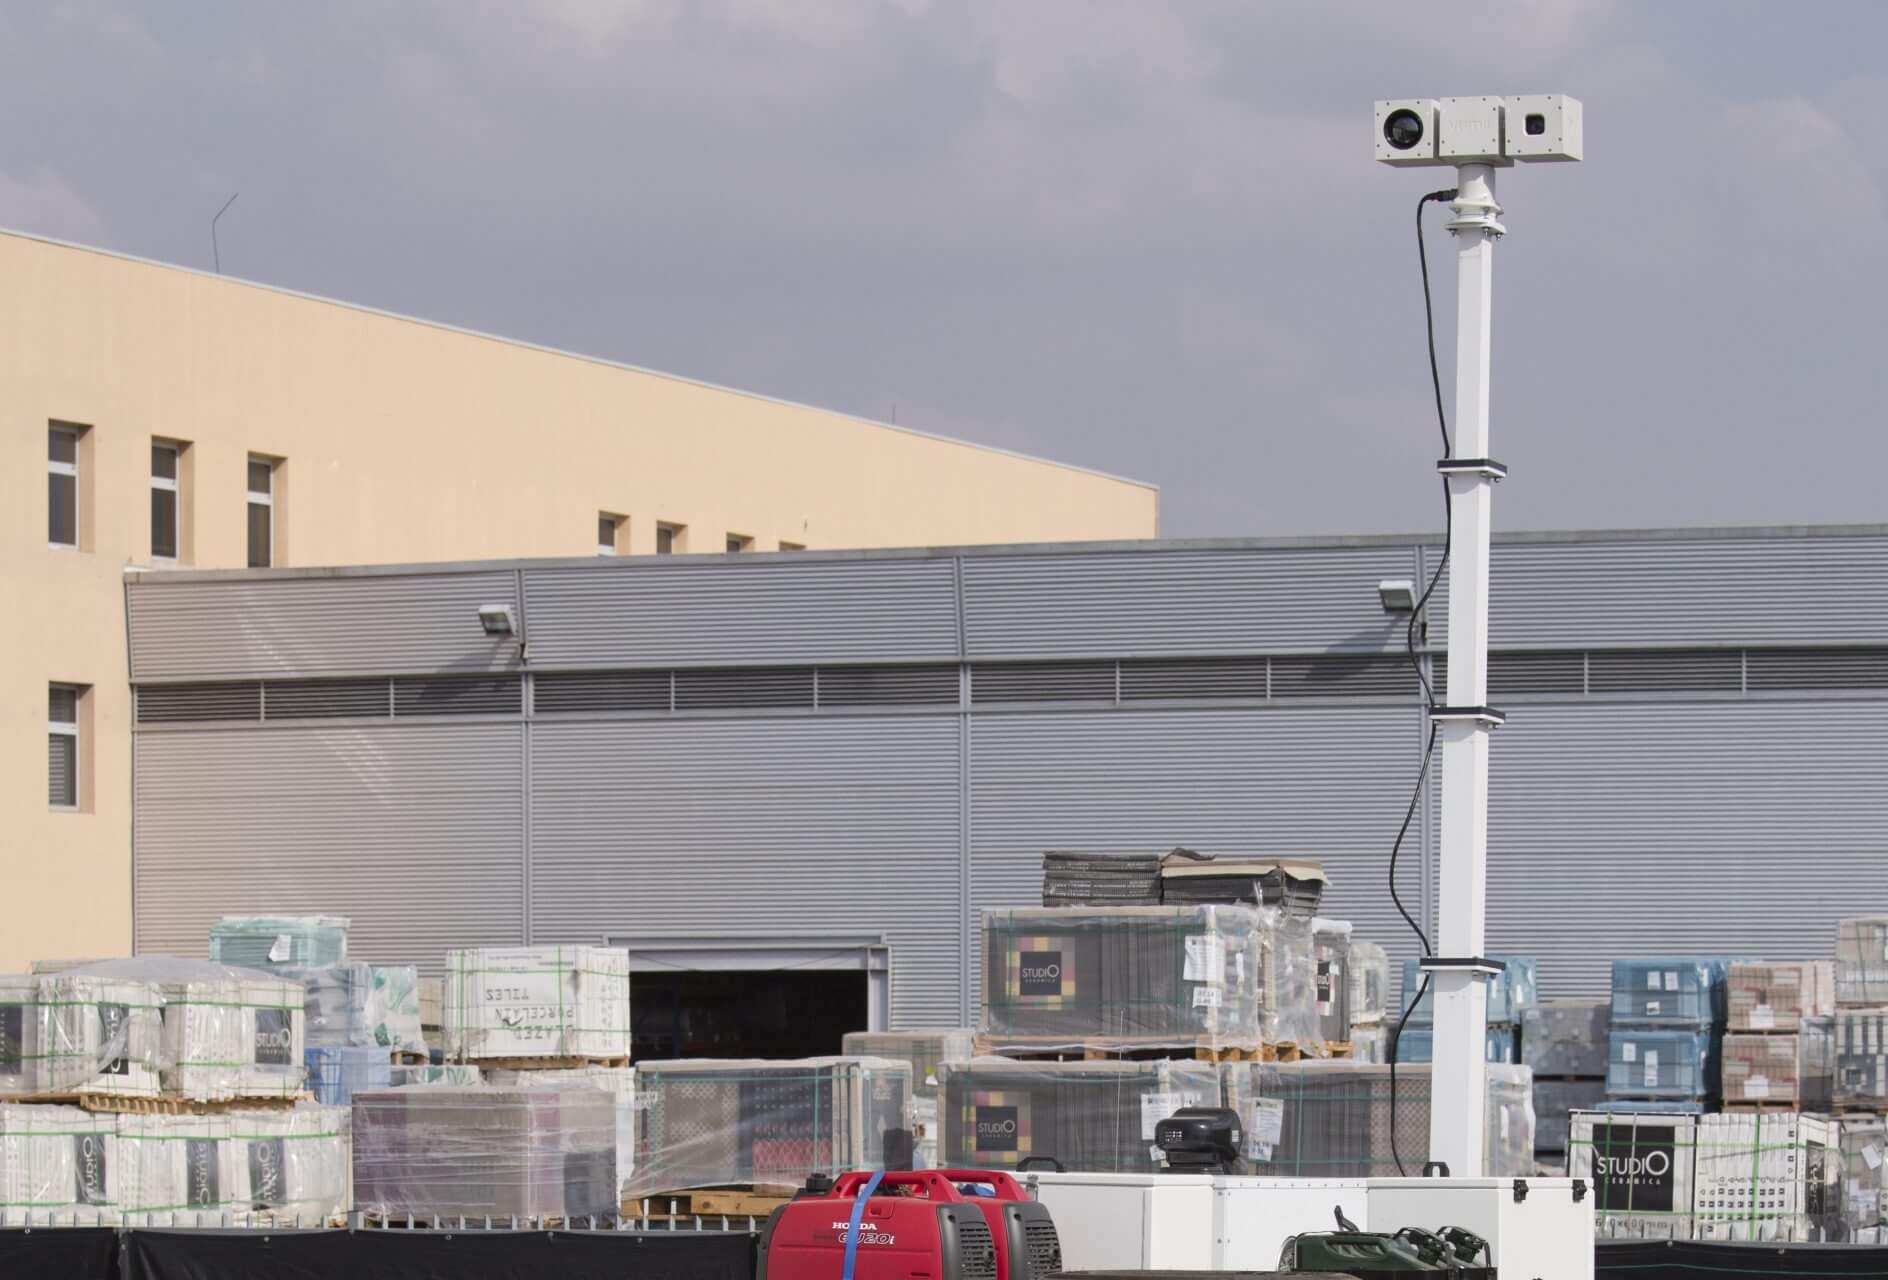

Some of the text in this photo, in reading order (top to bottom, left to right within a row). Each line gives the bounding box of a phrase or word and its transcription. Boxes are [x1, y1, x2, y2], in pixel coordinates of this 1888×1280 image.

[1022, 964, 1060, 978] STUDIO
[486, 988, 529, 1000] TILES
[256, 1028, 291, 1047] STUDIO
[977, 1120, 1016, 1133] STUDIO
[82, 1136, 95, 1198] TUDIO
[1596, 1150, 1670, 1175] STUDIO
[256, 1142, 272, 1199] TUDIO
[1604, 1177, 1661, 1185] CERAMICA
[832, 1222, 877, 1230] HODA
